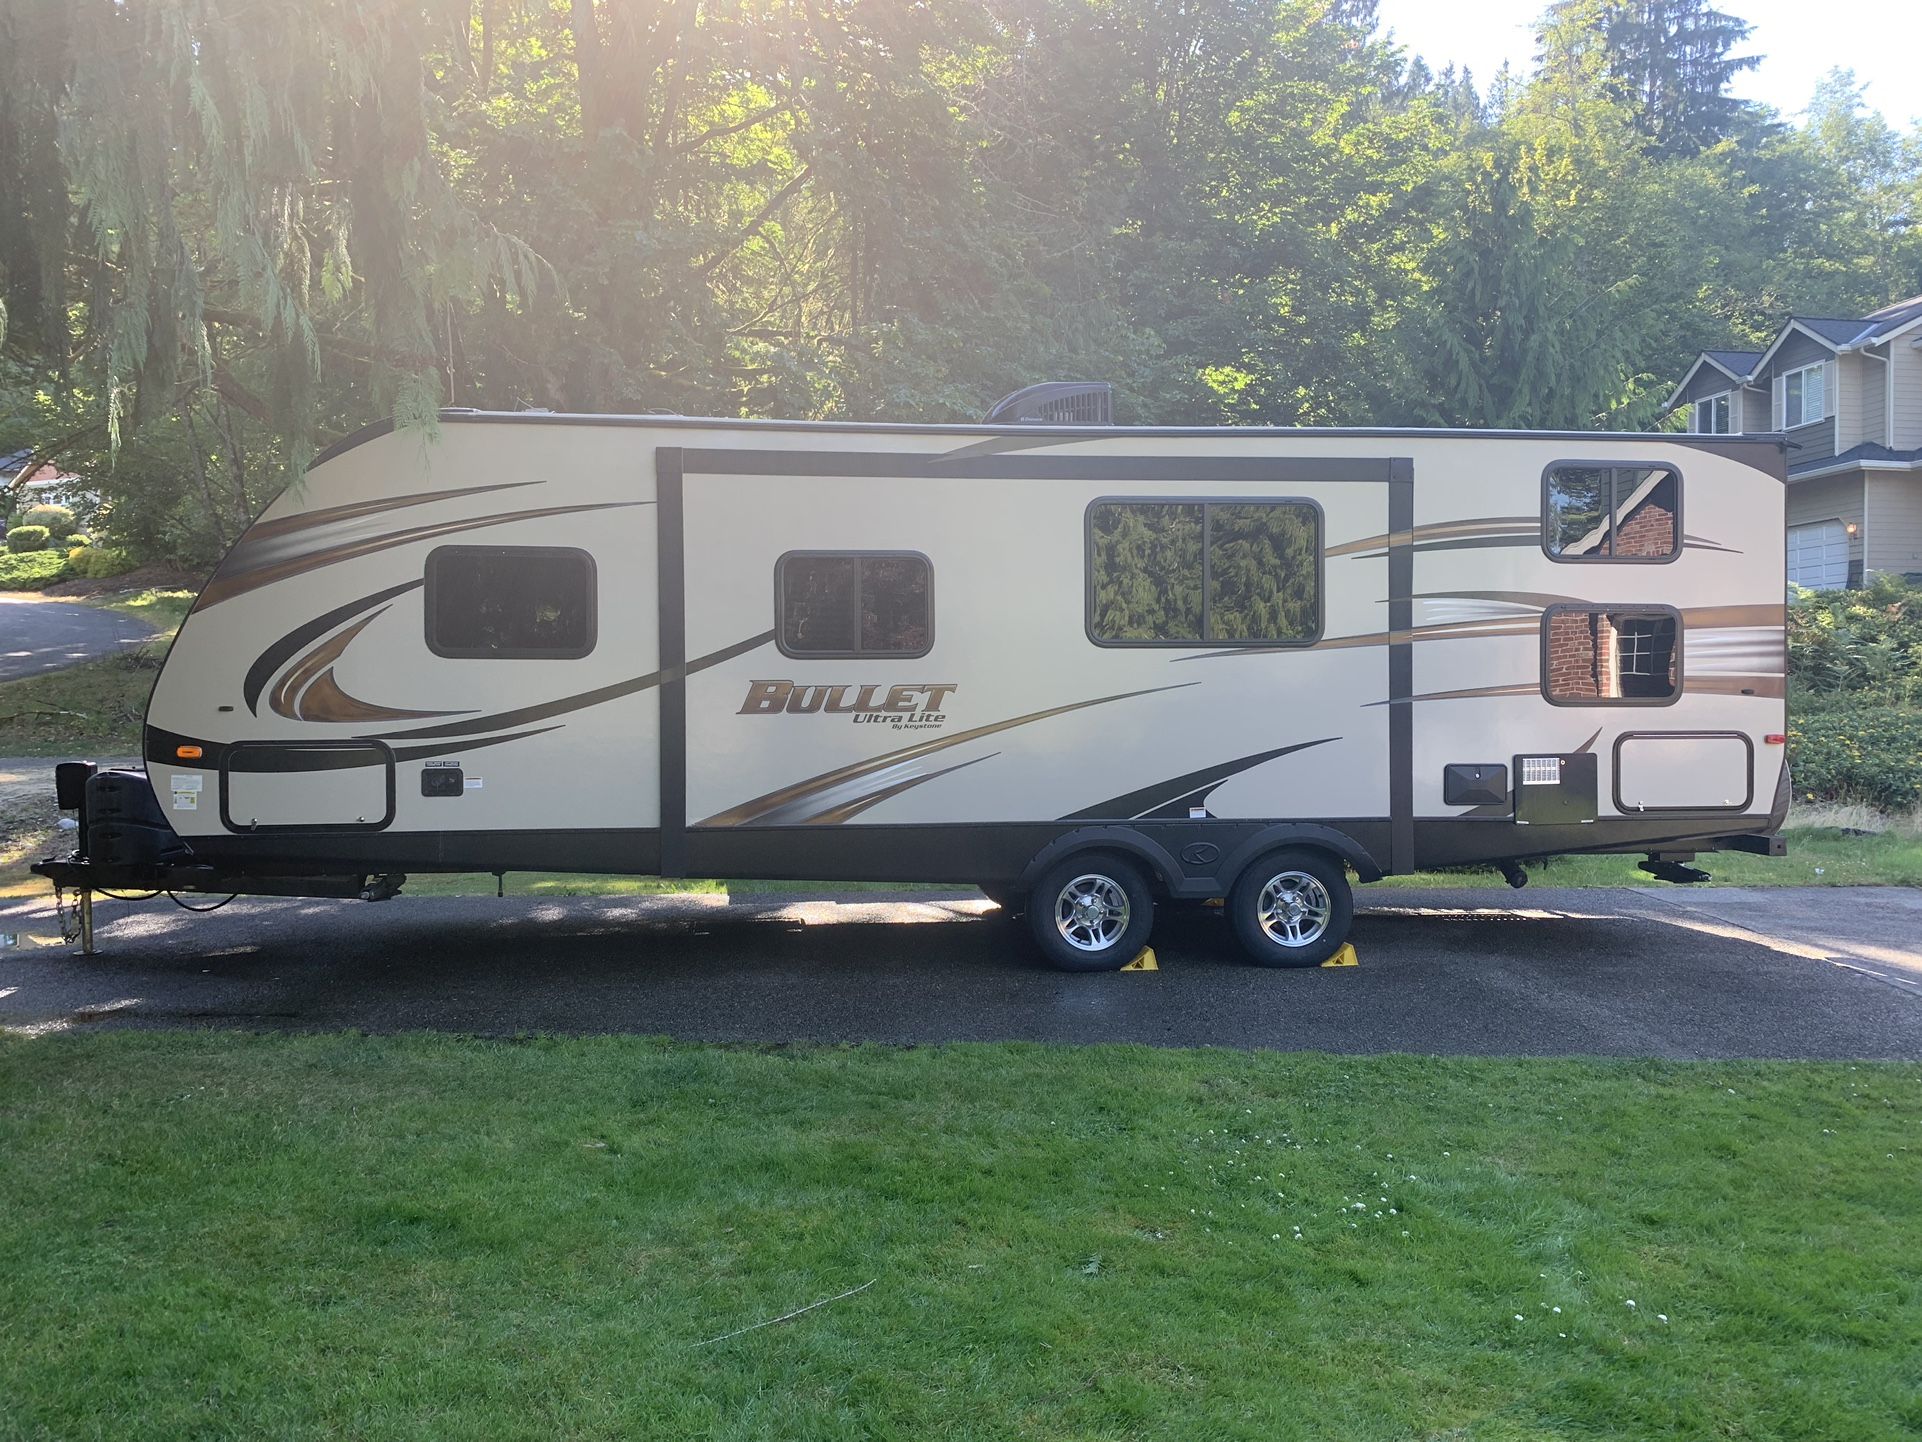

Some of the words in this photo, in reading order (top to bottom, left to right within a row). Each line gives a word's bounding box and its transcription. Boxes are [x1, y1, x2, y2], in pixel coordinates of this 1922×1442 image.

[736, 680, 958, 714] BULLET
[852, 713, 903, 723] Ultra
[907, 713, 946, 722] Lite
